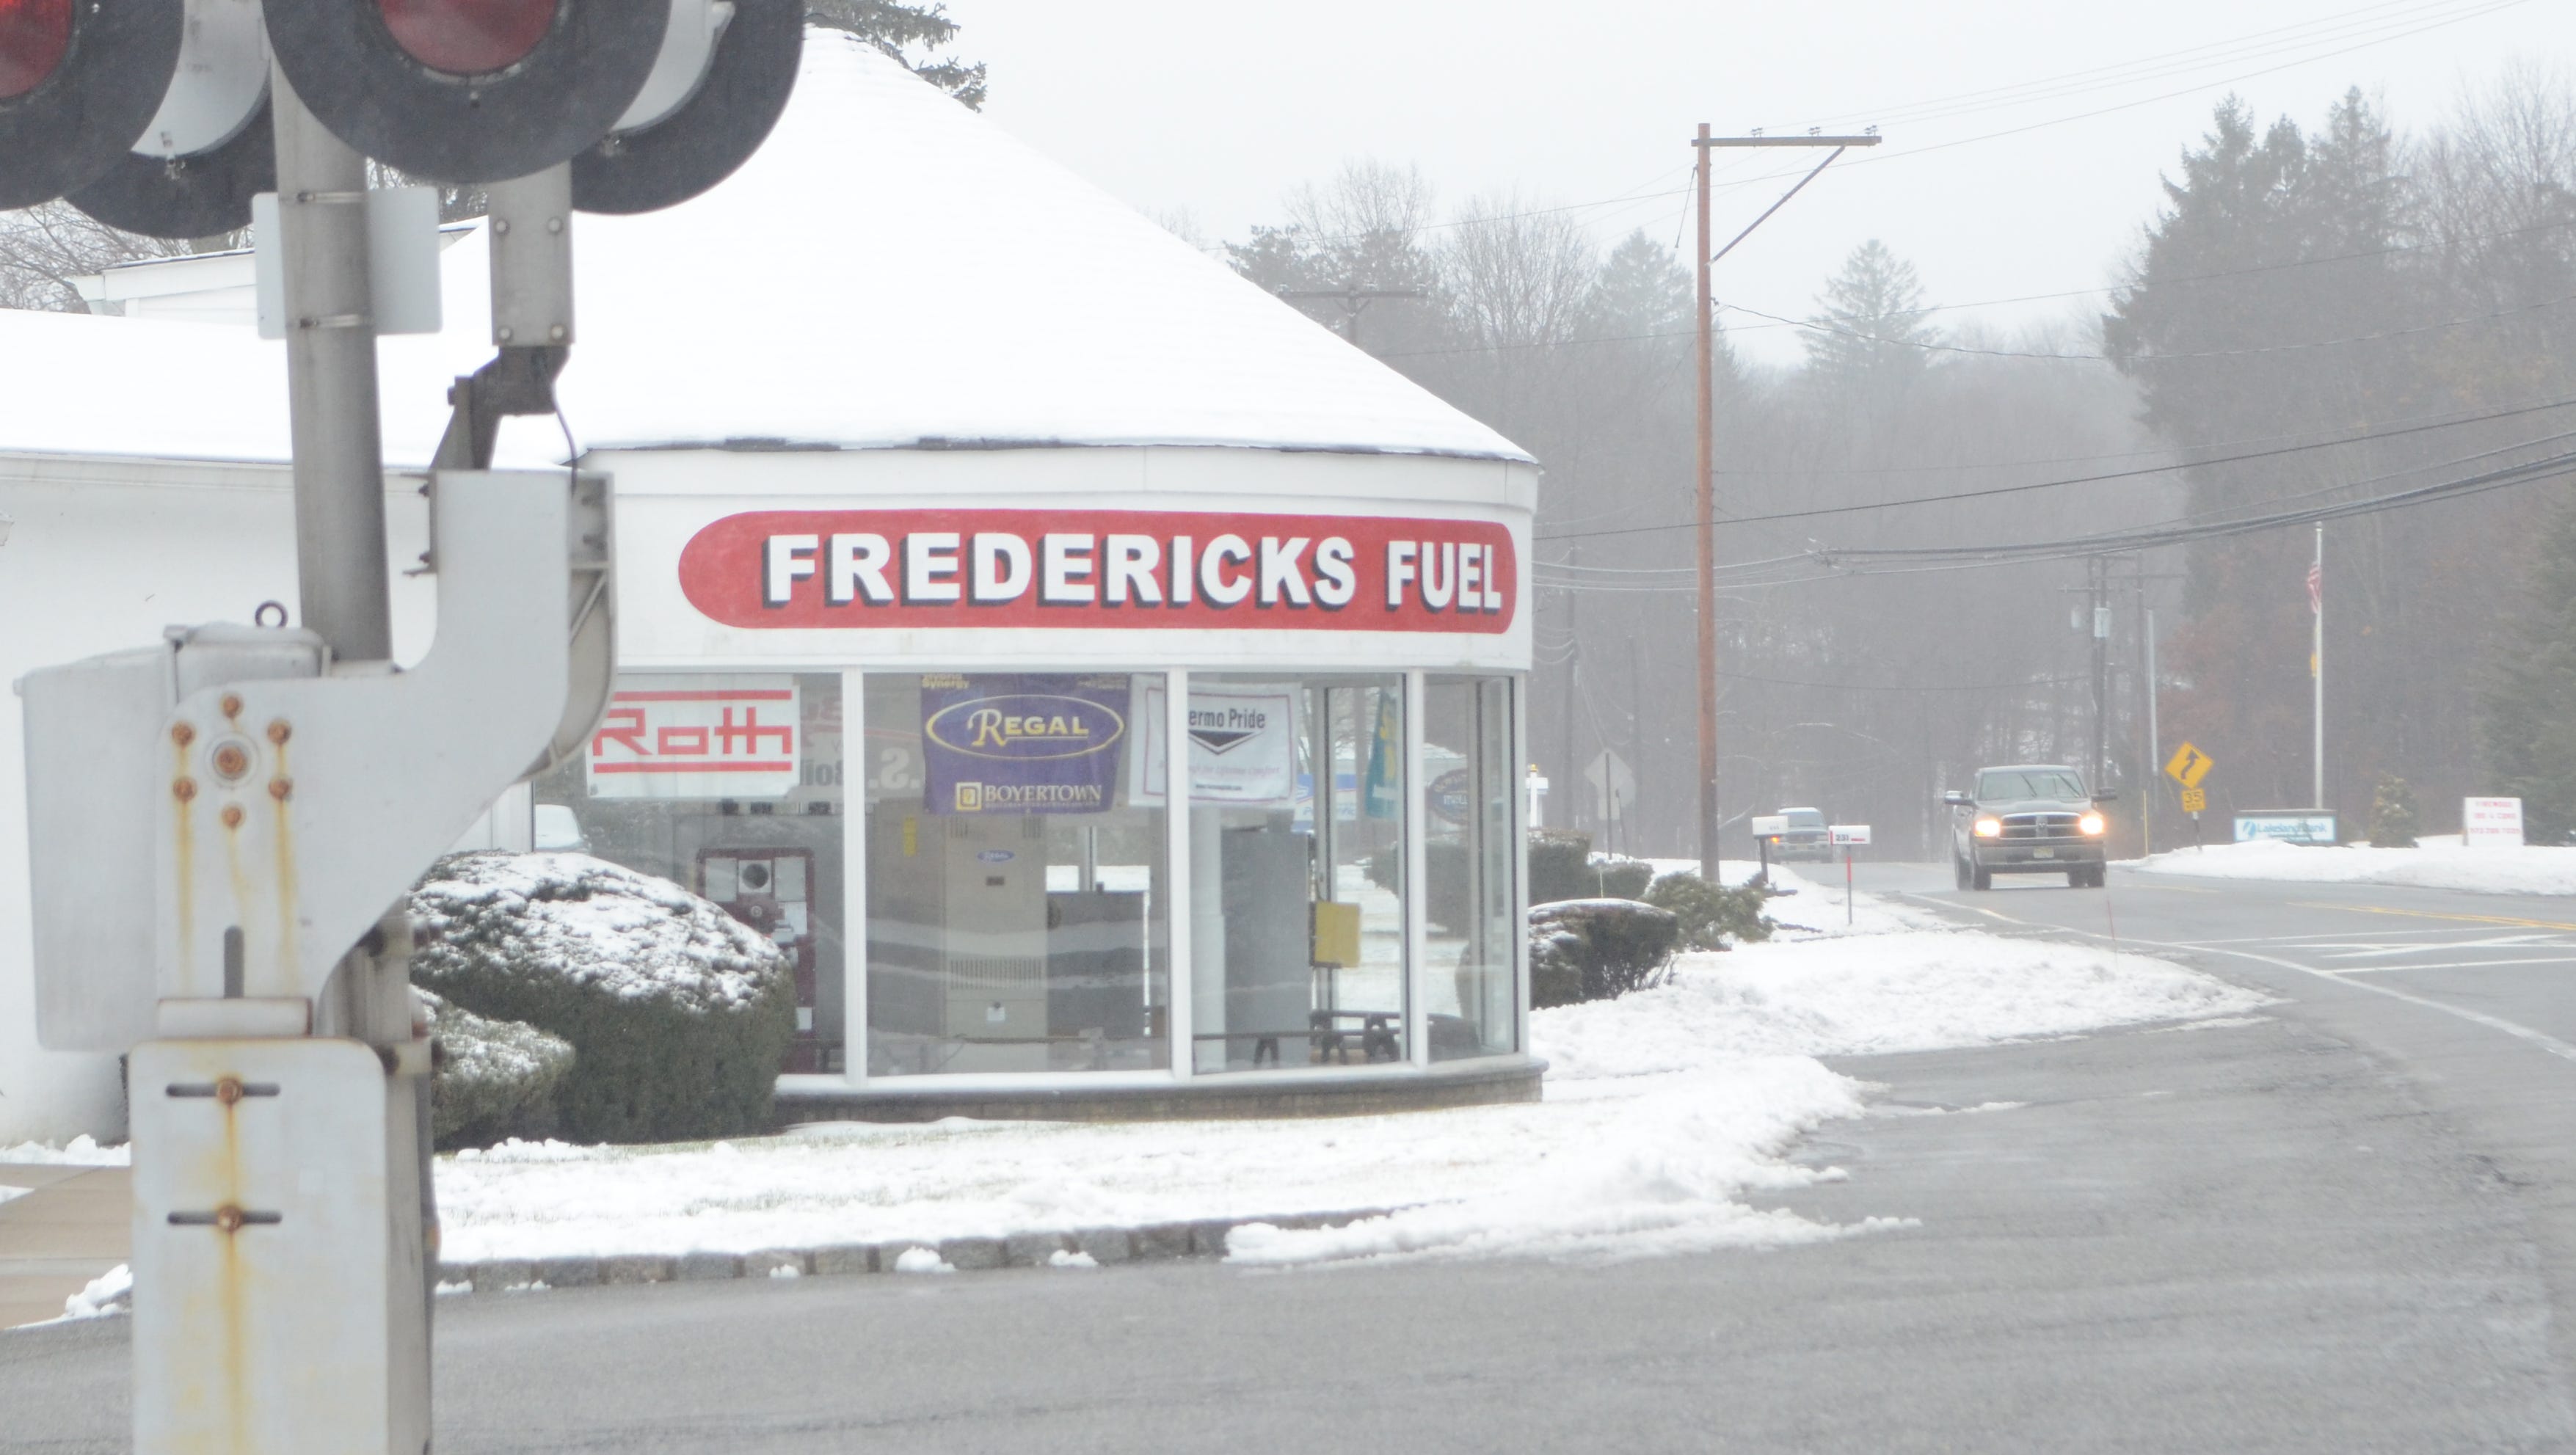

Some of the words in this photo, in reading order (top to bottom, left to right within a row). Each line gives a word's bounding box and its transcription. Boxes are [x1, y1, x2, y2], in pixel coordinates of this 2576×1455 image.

[763, 533, 1356, 611] FREDERICKS
[1386, 541, 1502, 612] FUEL
[1188, 710, 1225, 728] ermo
[1229, 708, 1266, 729] Pride
[592, 706, 793, 756] Roth
[985, 784, 1102, 803] BOYERTOWN
[2184, 791, 2203, 803] 35
[1836, 834, 1849, 842] 231
